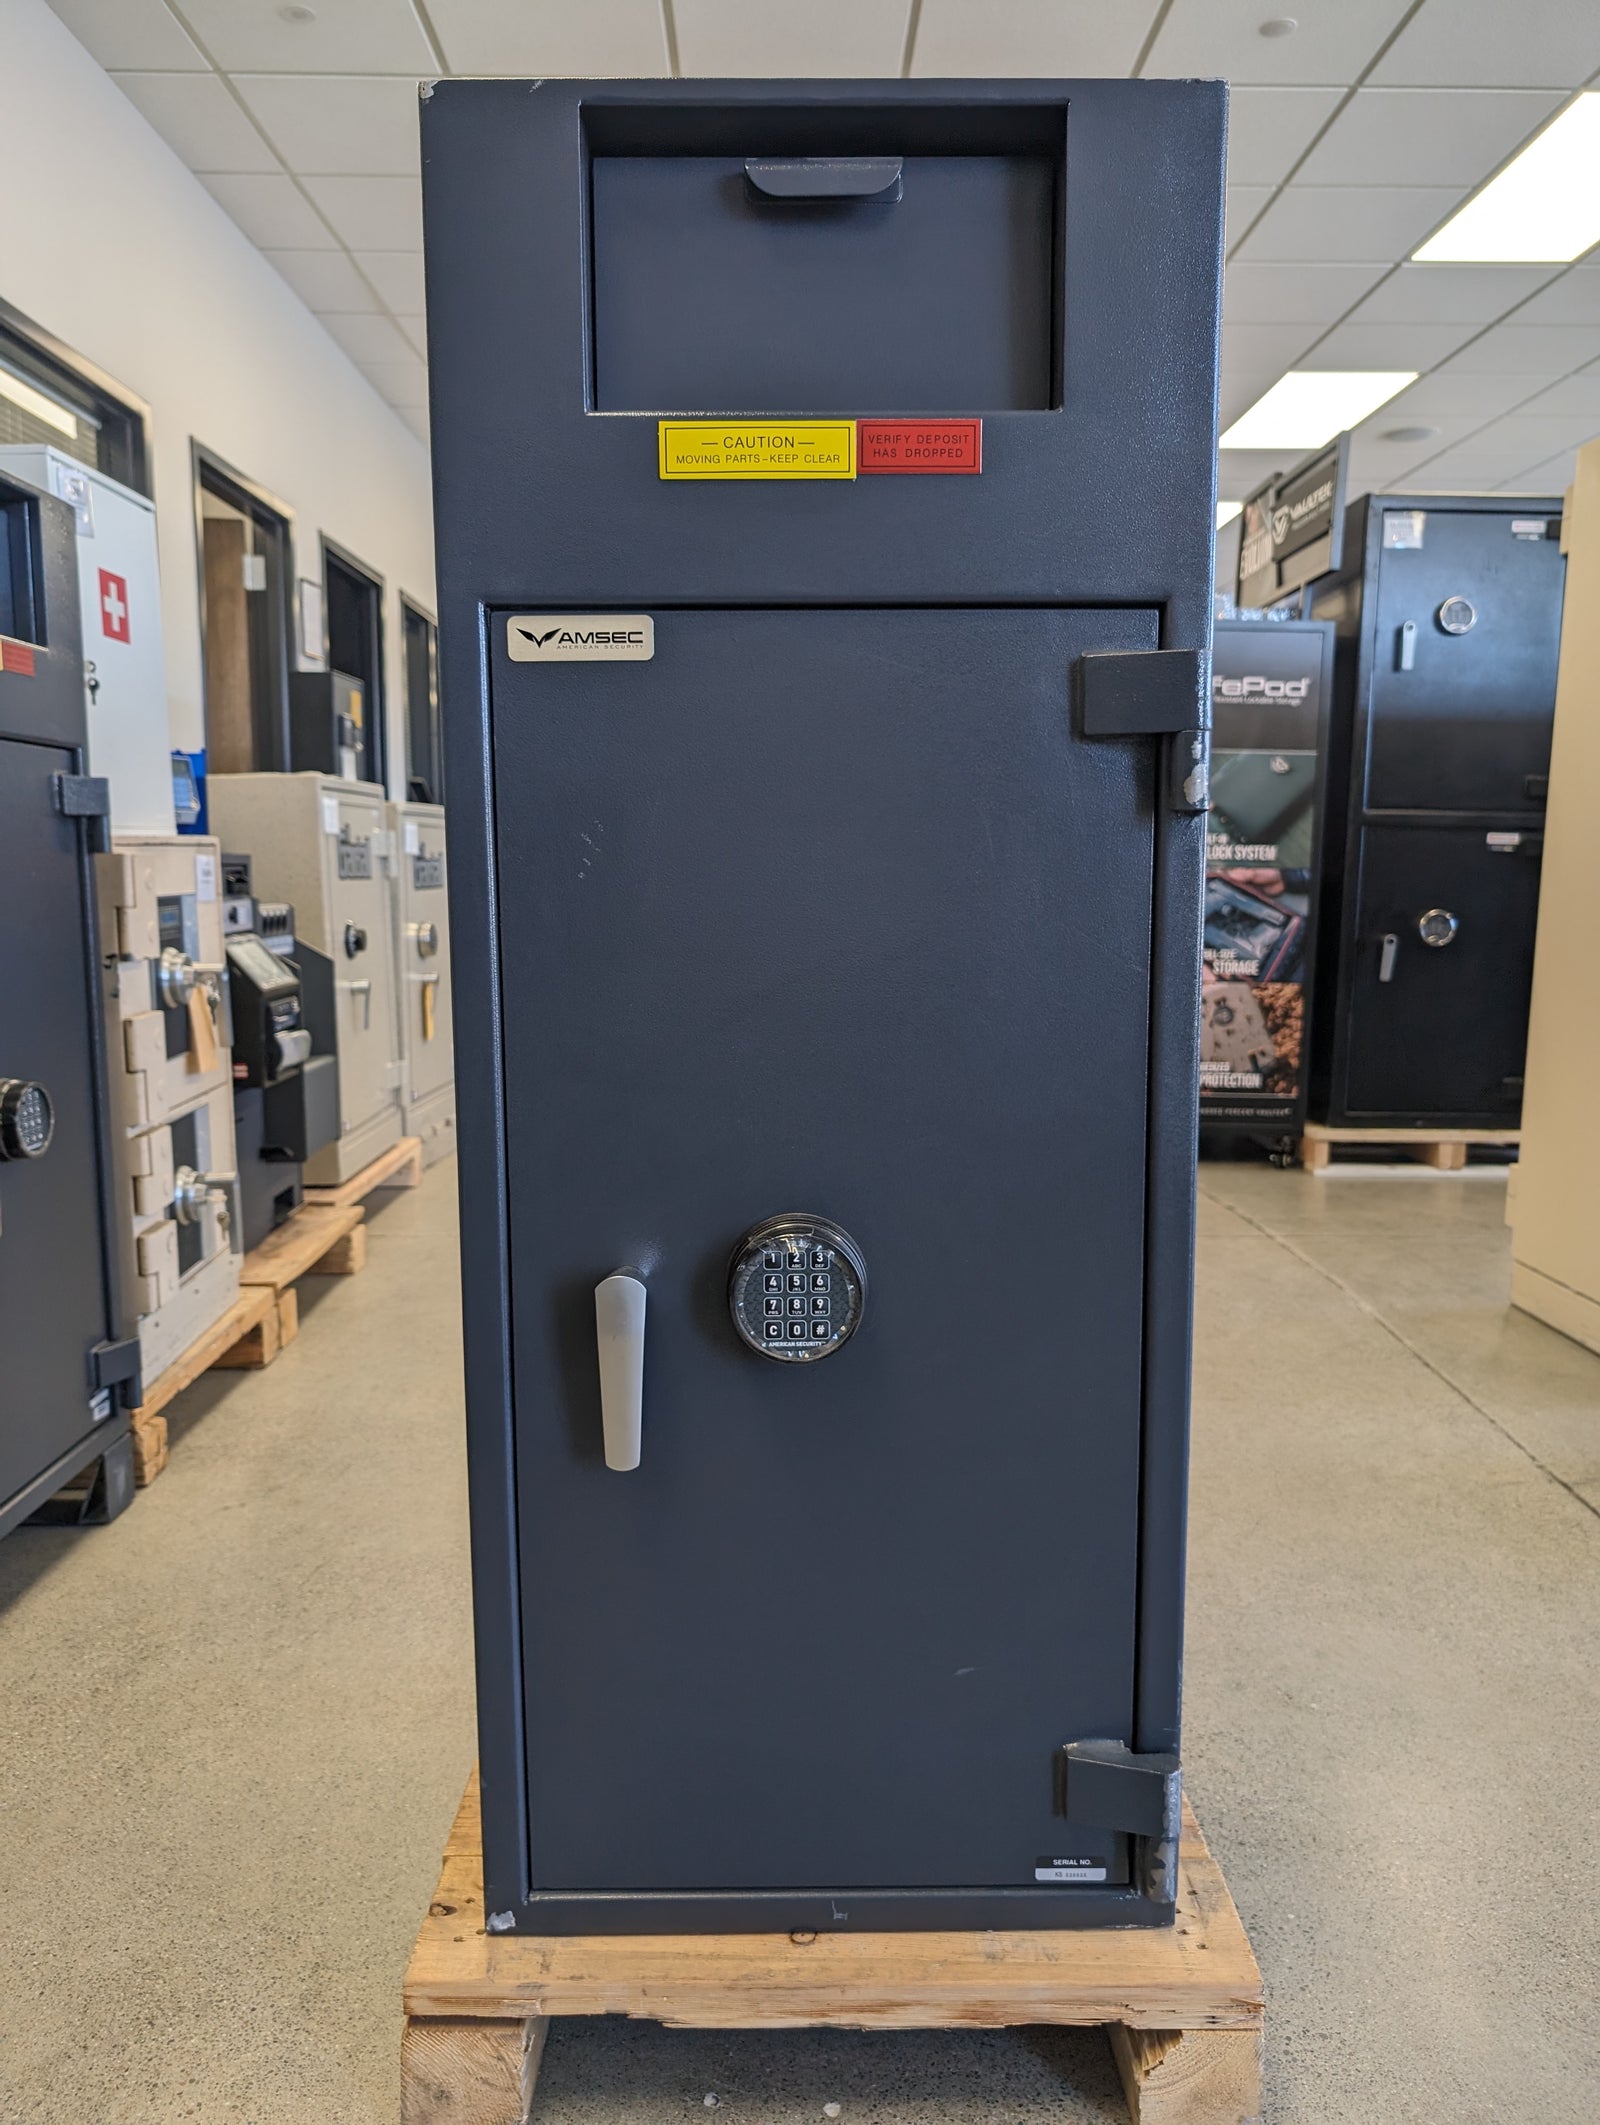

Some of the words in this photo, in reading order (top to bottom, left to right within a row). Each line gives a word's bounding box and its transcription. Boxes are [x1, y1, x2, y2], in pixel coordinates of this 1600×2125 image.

[723, 436, 795, 449] CAUTION
[868, 434, 911, 445] VERIFY
[917, 434, 969, 445] DEPOSIT
[676, 454, 721, 465] MOVING
[804, 453, 841, 464] CLEAR
[873, 448, 897, 459] HAS
[905, 448, 963, 458] DROPPED
[558, 631, 644, 644] AMSEC
[1234, 844, 1278, 861] SYSTEM
[1212, 959, 1260, 977] STORAGE
[770, 1253, 776, 1263] 1
[793, 1252, 800, 1263] 2
[816, 1252, 824, 1263] 3
[769, 1276, 777, 1287] 4
[793, 1275, 800, 1286] 5
[816, 1275, 824, 1286] 6
[769, 1300, 777, 1310] 7
[793, 1299, 801, 1310] 8
[816, 1298, 824, 1309] 9
[769, 1325, 778, 1336] C
[816, 1324, 825, 1335] #
